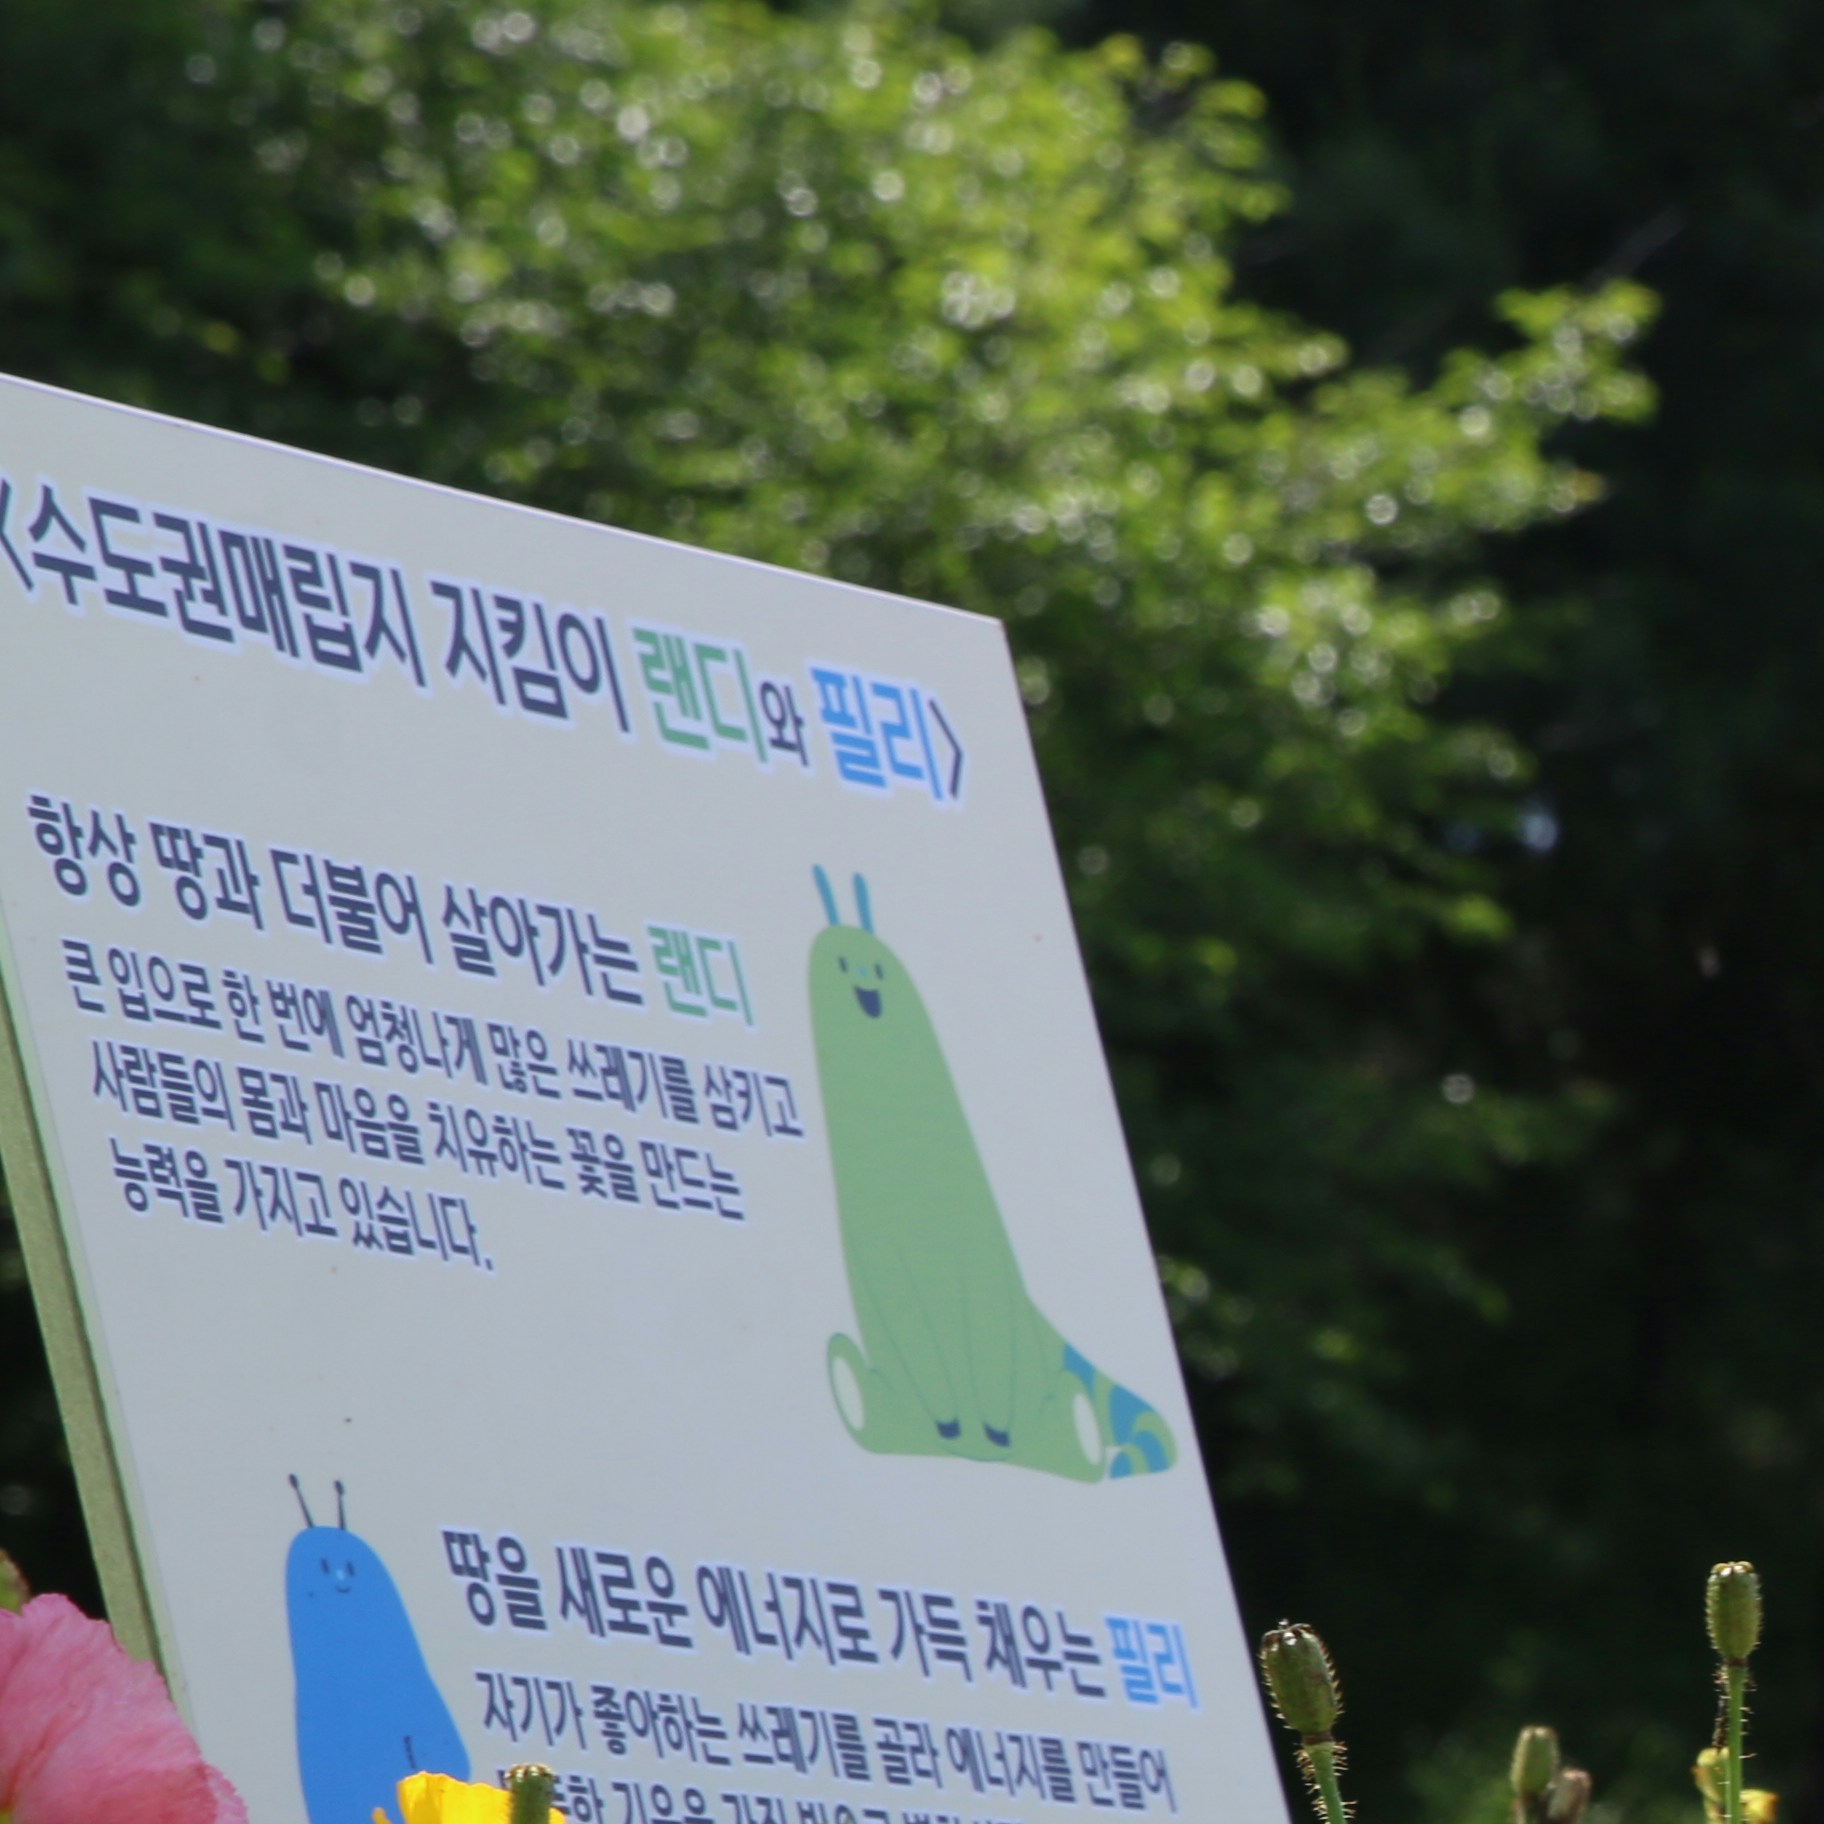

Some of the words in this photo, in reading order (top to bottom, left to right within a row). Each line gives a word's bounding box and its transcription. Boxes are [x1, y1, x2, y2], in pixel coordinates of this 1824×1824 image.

[430, 581, 629, 734] 지킴이
[632, 628, 809, 767] 랜디와
[28, 795, 141, 907] 항상
[149, 822, 264, 930] 땅과
[269, 849, 433, 965] 더불어
[443, 884, 643, 1005] 살아가는
[647, 926, 753, 1026] 랜디
[62, 939, 105, 1014] 큰
[108, 948, 222, 1029] 입으로
[221, 969, 265, 1043] 한
[266, 979, 345, 1058] 번에
[346, 996, 488, 1086] 엄청나게
[487, 1022, 562, 1099] 많은
[567, 1039, 699, 1124] 쓰레기를
[704, 1064, 803, 1137] 삼키고
[92, 1041, 236, 1131] 사람들의
[237, 1066, 312, 1145] 몸과
[314, 1082, 424, 1165] 마음을
[426, 1101, 565, 1190] 치유하는
[566, 1127, 640, 1203] 꽃을
[638, 1140, 744, 1220] 만드는
[109, 1138, 224, 1223] 능력을
[224, 1159, 338, 1237] 가지고
[339, 1177, 493, 1270] 있습니다.
[442, 1530, 548, 1631] 땅을
[555, 1546, 693, 1649] 새로운
[696, 1565, 876, 1666] 에너지로
[877, 1588, 973, 1683] 가득
[975, 1599, 1106, 1698] 채우는
[1105, 1616, 1199, 1708] 필리
[475, 1672, 586, 1750] 자기가
[590, 1684, 732, 1765] 좋아하는
[738, 1703, 871, 1780] 쓰레기를
[873, 1717, 943, 1789] 골라
[945, 1727, 1077, 1803] 에너지를
[1076, 1740, 1175, 1812] 만들어
